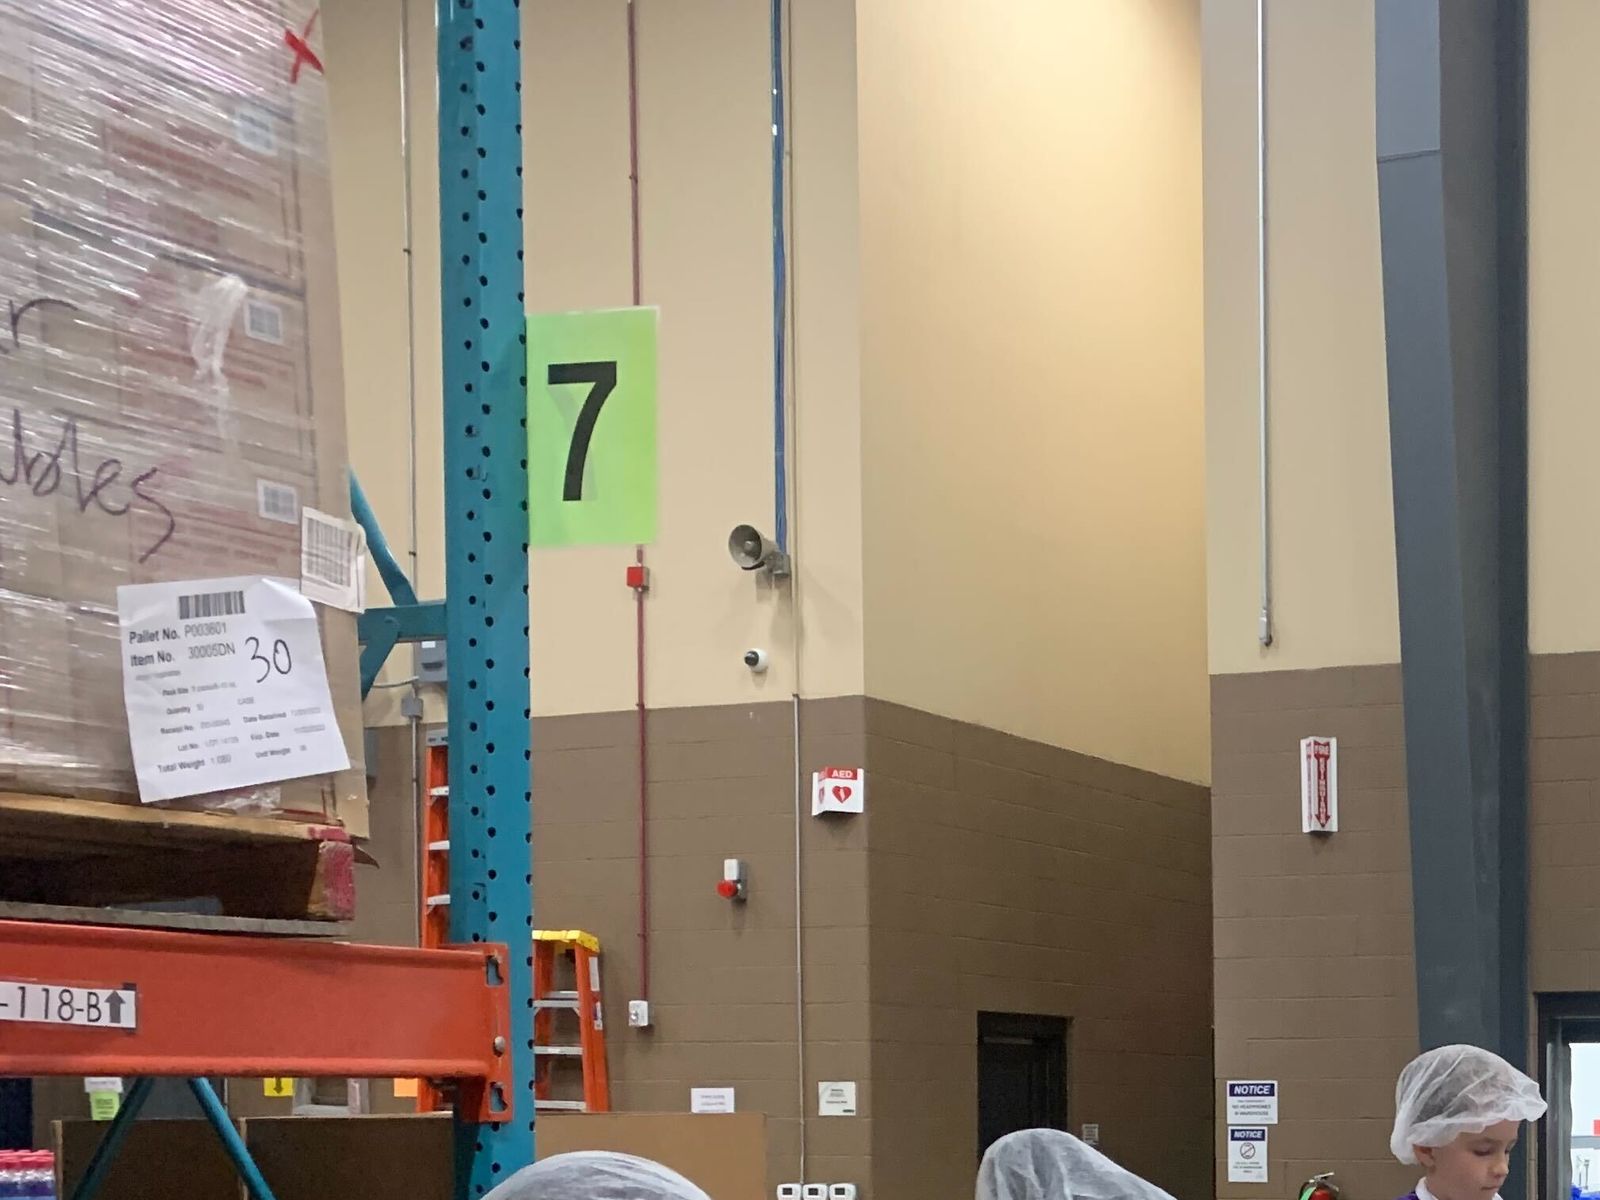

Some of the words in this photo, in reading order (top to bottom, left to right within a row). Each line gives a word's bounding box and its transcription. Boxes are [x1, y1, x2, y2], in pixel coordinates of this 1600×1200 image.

[548, 361, 617, 501] 7
[129, 629, 160, 645] Pallet
[163, 628, 180, 641] No.
[130, 653, 155, 667] Item
[157, 650, 175, 663] No.
[244, 636, 292, 684] 30
[158, 763, 177, 773] Total
[179, 758, 205, 770] Weight
[831, 769, 854, 778] AED
[1233, 1085, 1271, 1094] NOTICE
[1233, 1131, 1263, 1139] NOTICE
